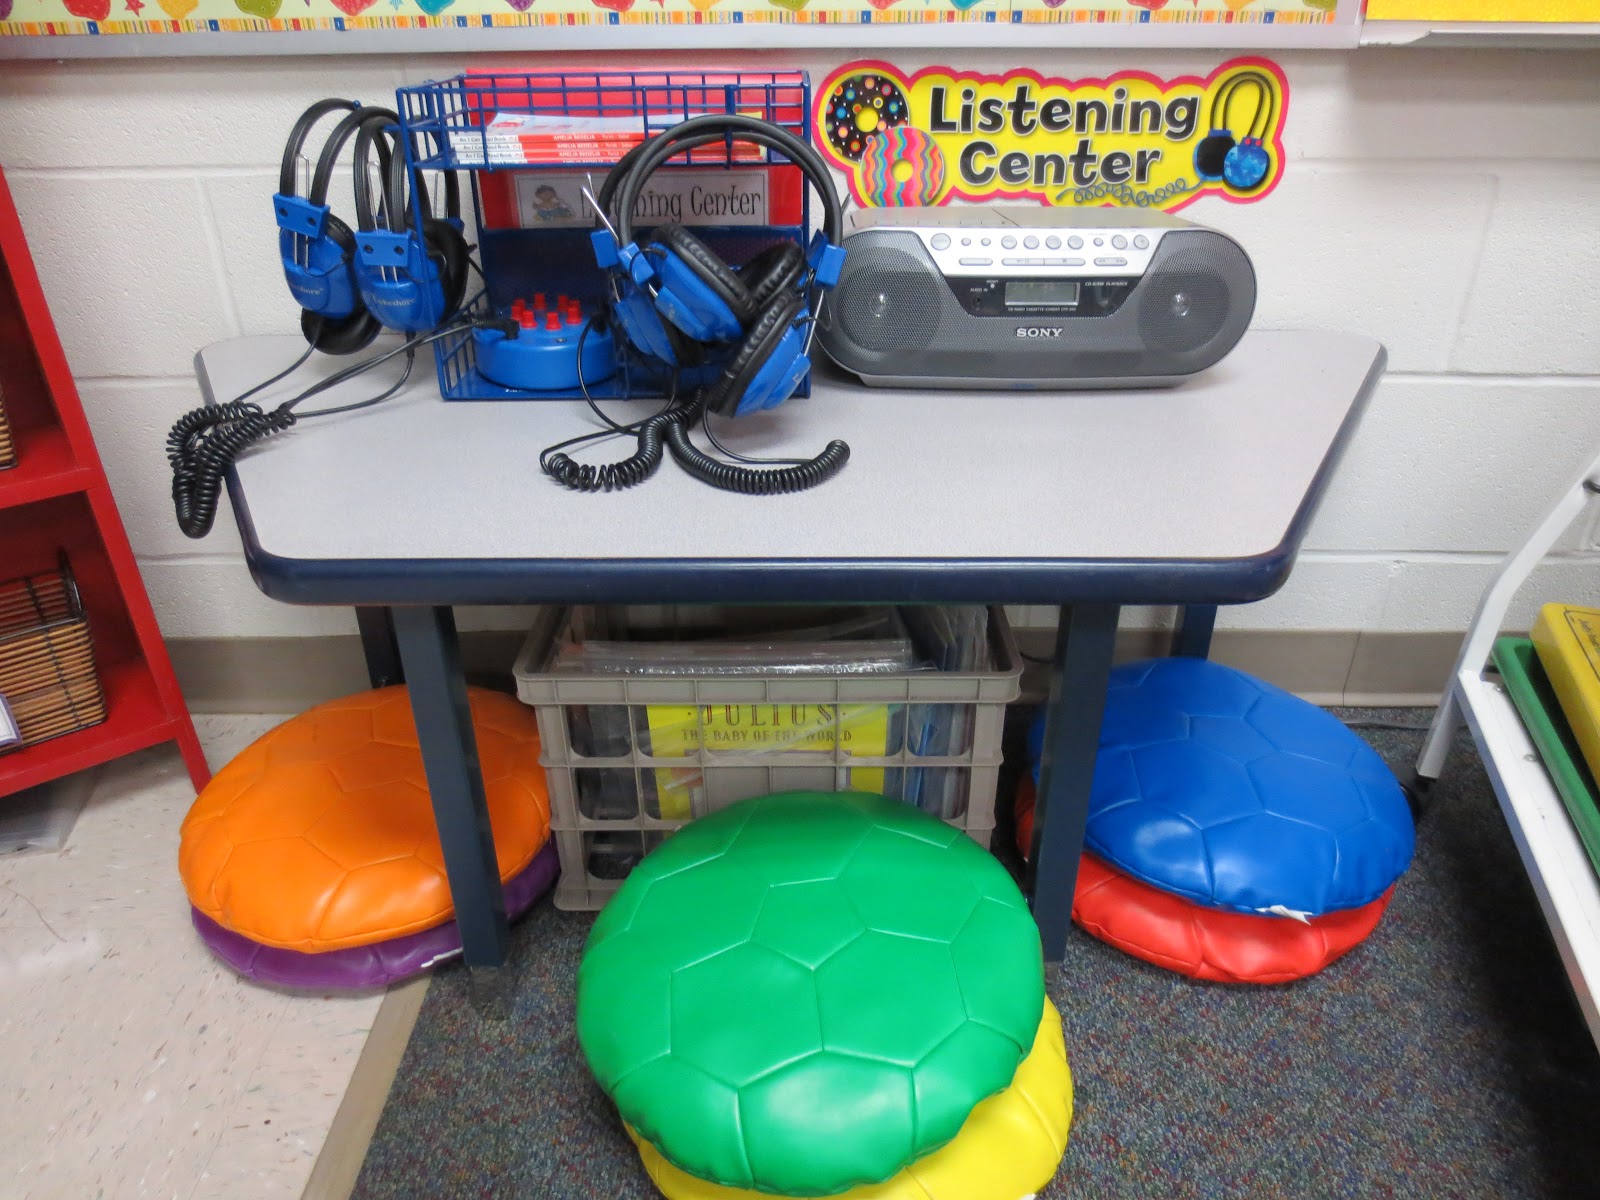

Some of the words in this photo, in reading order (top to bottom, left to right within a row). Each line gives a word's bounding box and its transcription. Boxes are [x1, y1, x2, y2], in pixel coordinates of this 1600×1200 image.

[930, 85, 1199, 140] Listening
[959, 138, 1162, 187] Center
[691, 185, 761, 216] Center
[1016, 327, 1063, 338] SONY
[713, 729, 748, 741] BABY
[753, 730, 770, 741] OF
